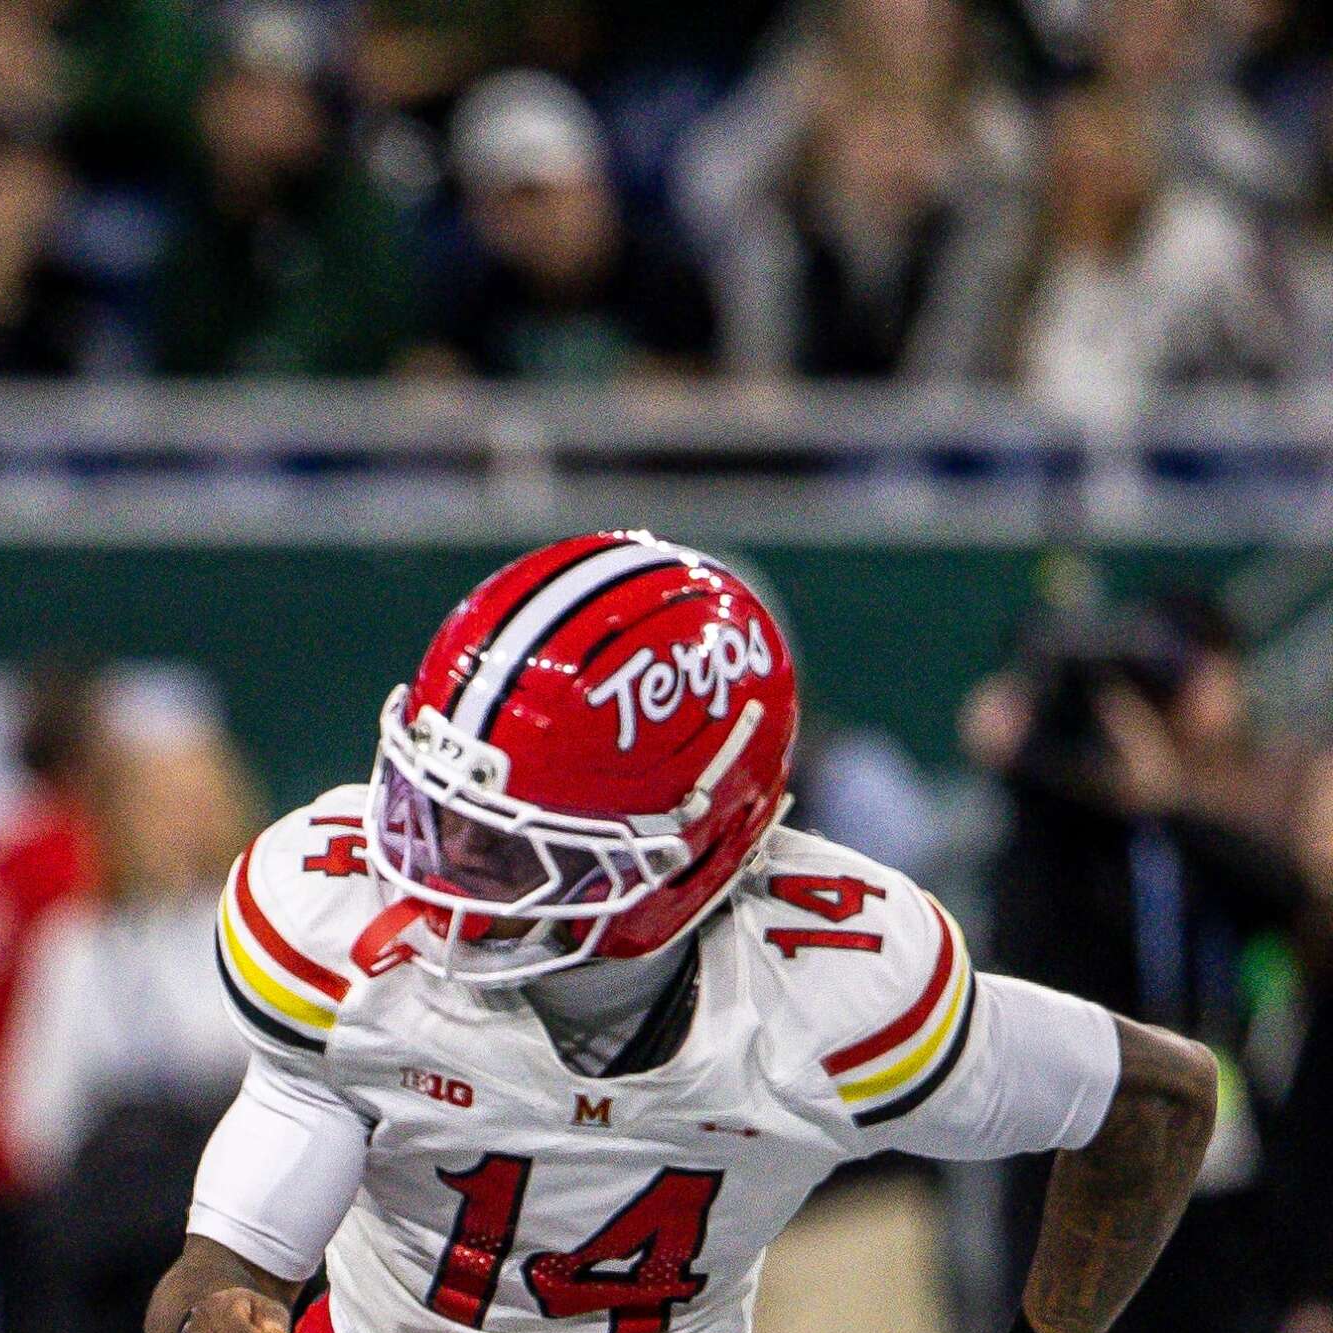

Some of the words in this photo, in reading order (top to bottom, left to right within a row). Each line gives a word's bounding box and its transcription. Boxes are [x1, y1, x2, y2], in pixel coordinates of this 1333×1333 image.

[587, 617, 773, 752] Terps
[764, 873, 886, 959] 14
[572, 1094, 614, 1128] M
